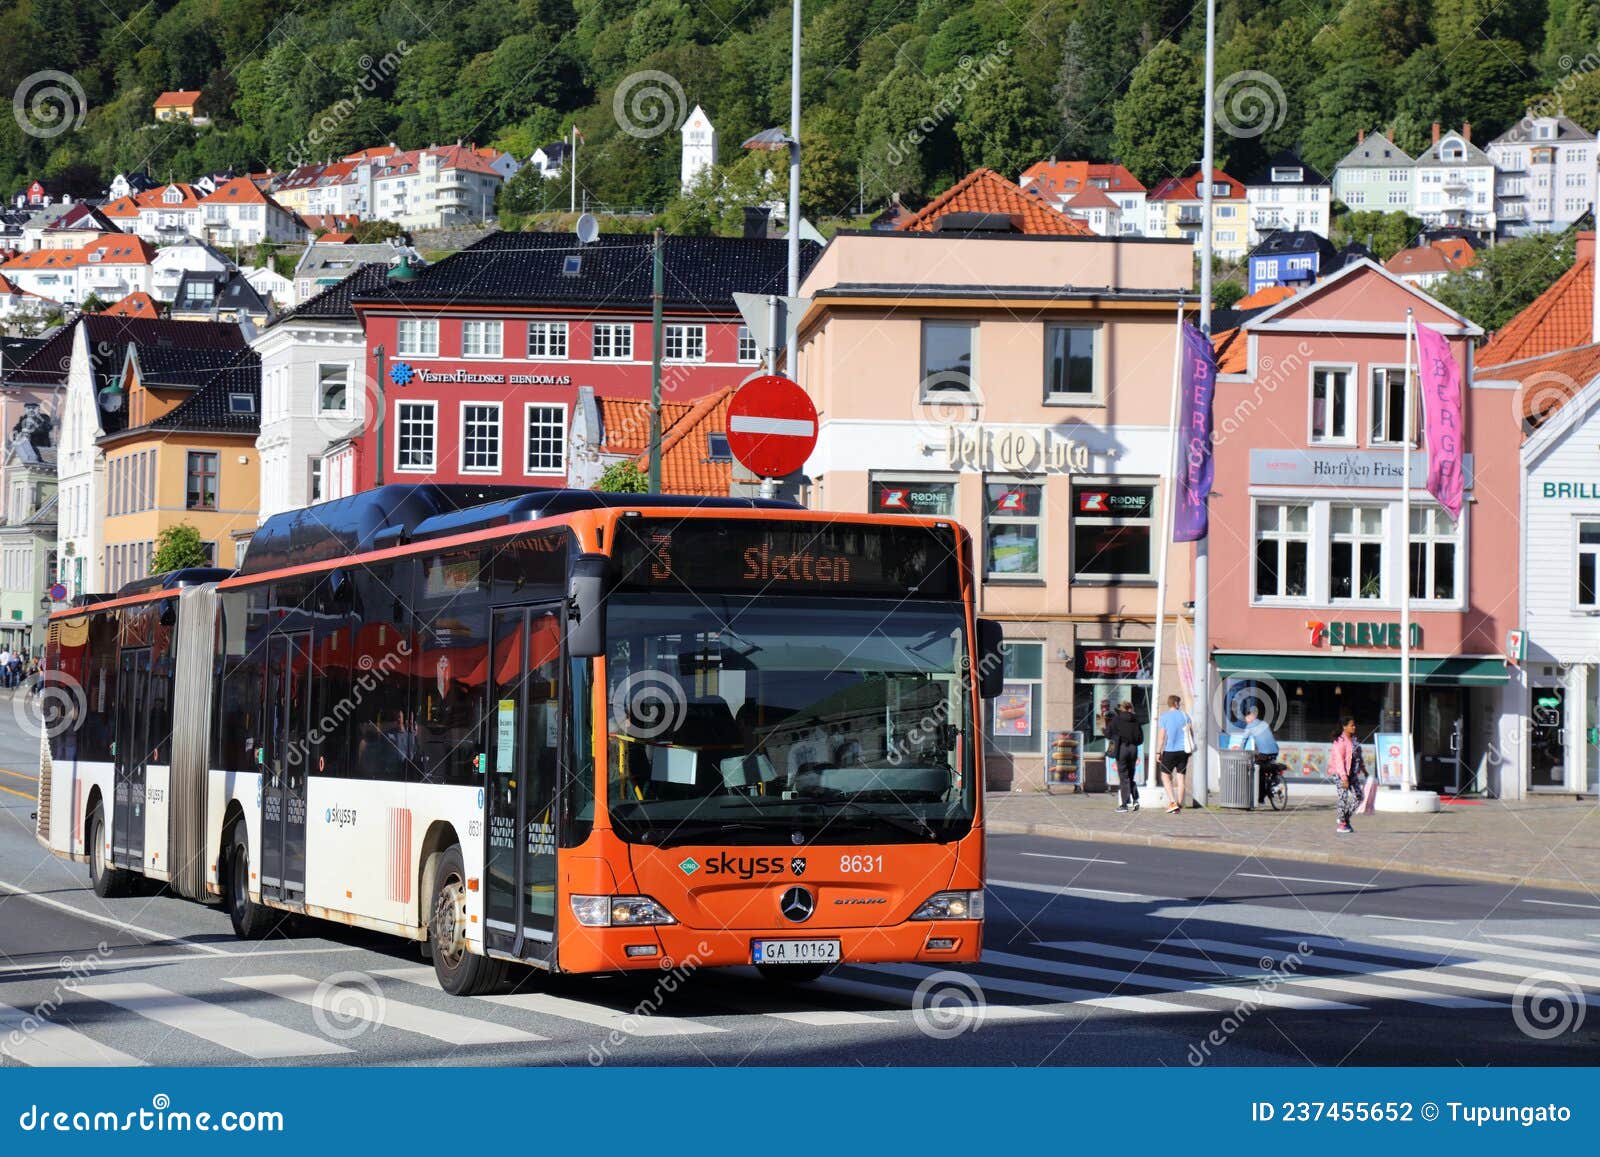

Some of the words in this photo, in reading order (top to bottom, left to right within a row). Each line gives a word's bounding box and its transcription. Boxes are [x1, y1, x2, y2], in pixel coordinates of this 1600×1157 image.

[509, 375, 555, 385] EIENDOM
[556, 376, 571, 385] AS
[945, 424, 988, 472] Deli
[1040, 427, 1089, 470] Luca
[1373, 461, 1413, 477] Frise
[910, 492, 948, 502] RØDNE
[1110, 495, 1146, 505] RØDNE
[651, 533, 672, 580] 3
[331, 803, 351, 828] skyss
[705, 851, 785, 880] skyss
[839, 855, 883, 873] 8631
[766, 943, 786, 958] GA
[793, 943, 835, 958] 10162
